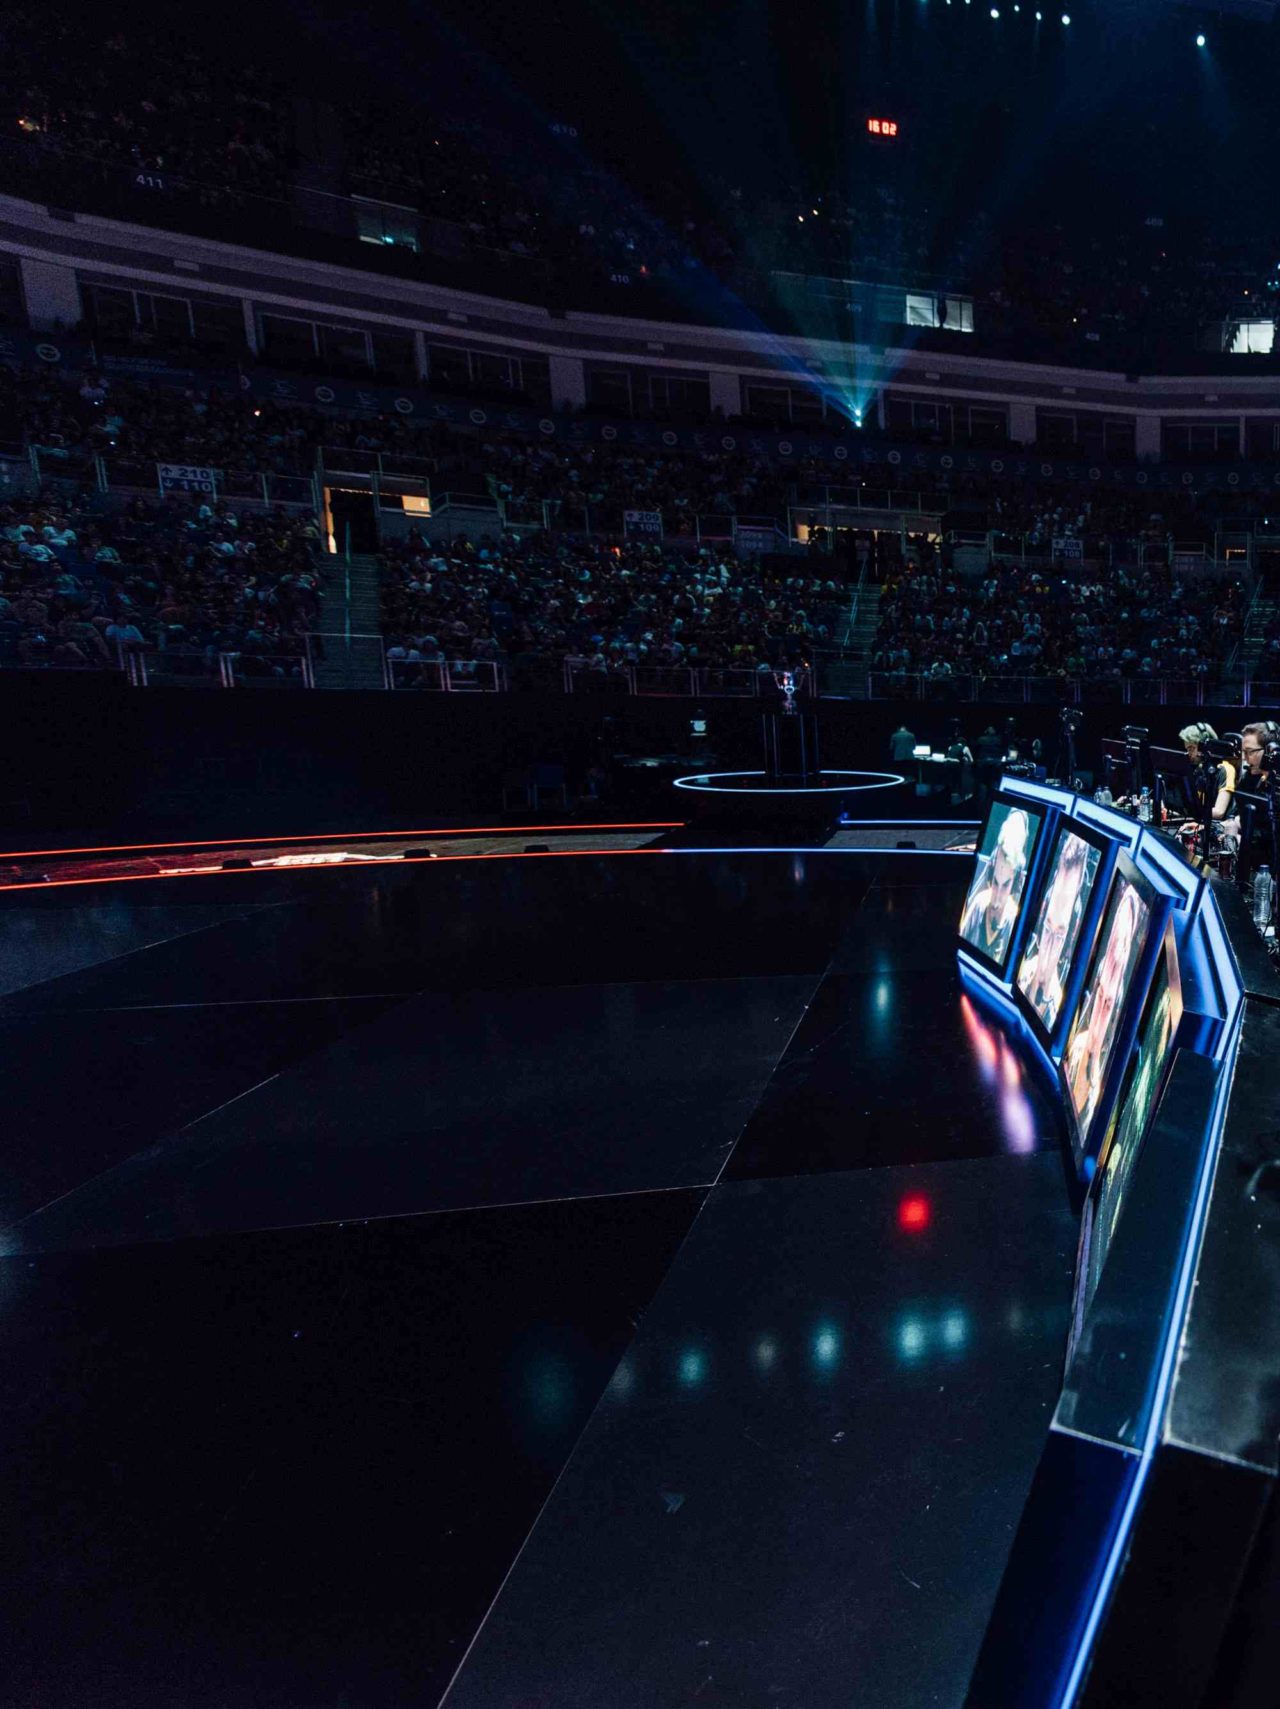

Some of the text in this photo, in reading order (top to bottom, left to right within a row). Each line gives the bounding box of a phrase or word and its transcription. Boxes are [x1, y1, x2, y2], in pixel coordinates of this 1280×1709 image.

[136, 174, 163, 189] 411
[611, 274, 630, 285] 410
[180, 467, 210, 479] 210
[183, 480, 210, 492] 110
[638, 512, 659, 522] 209
